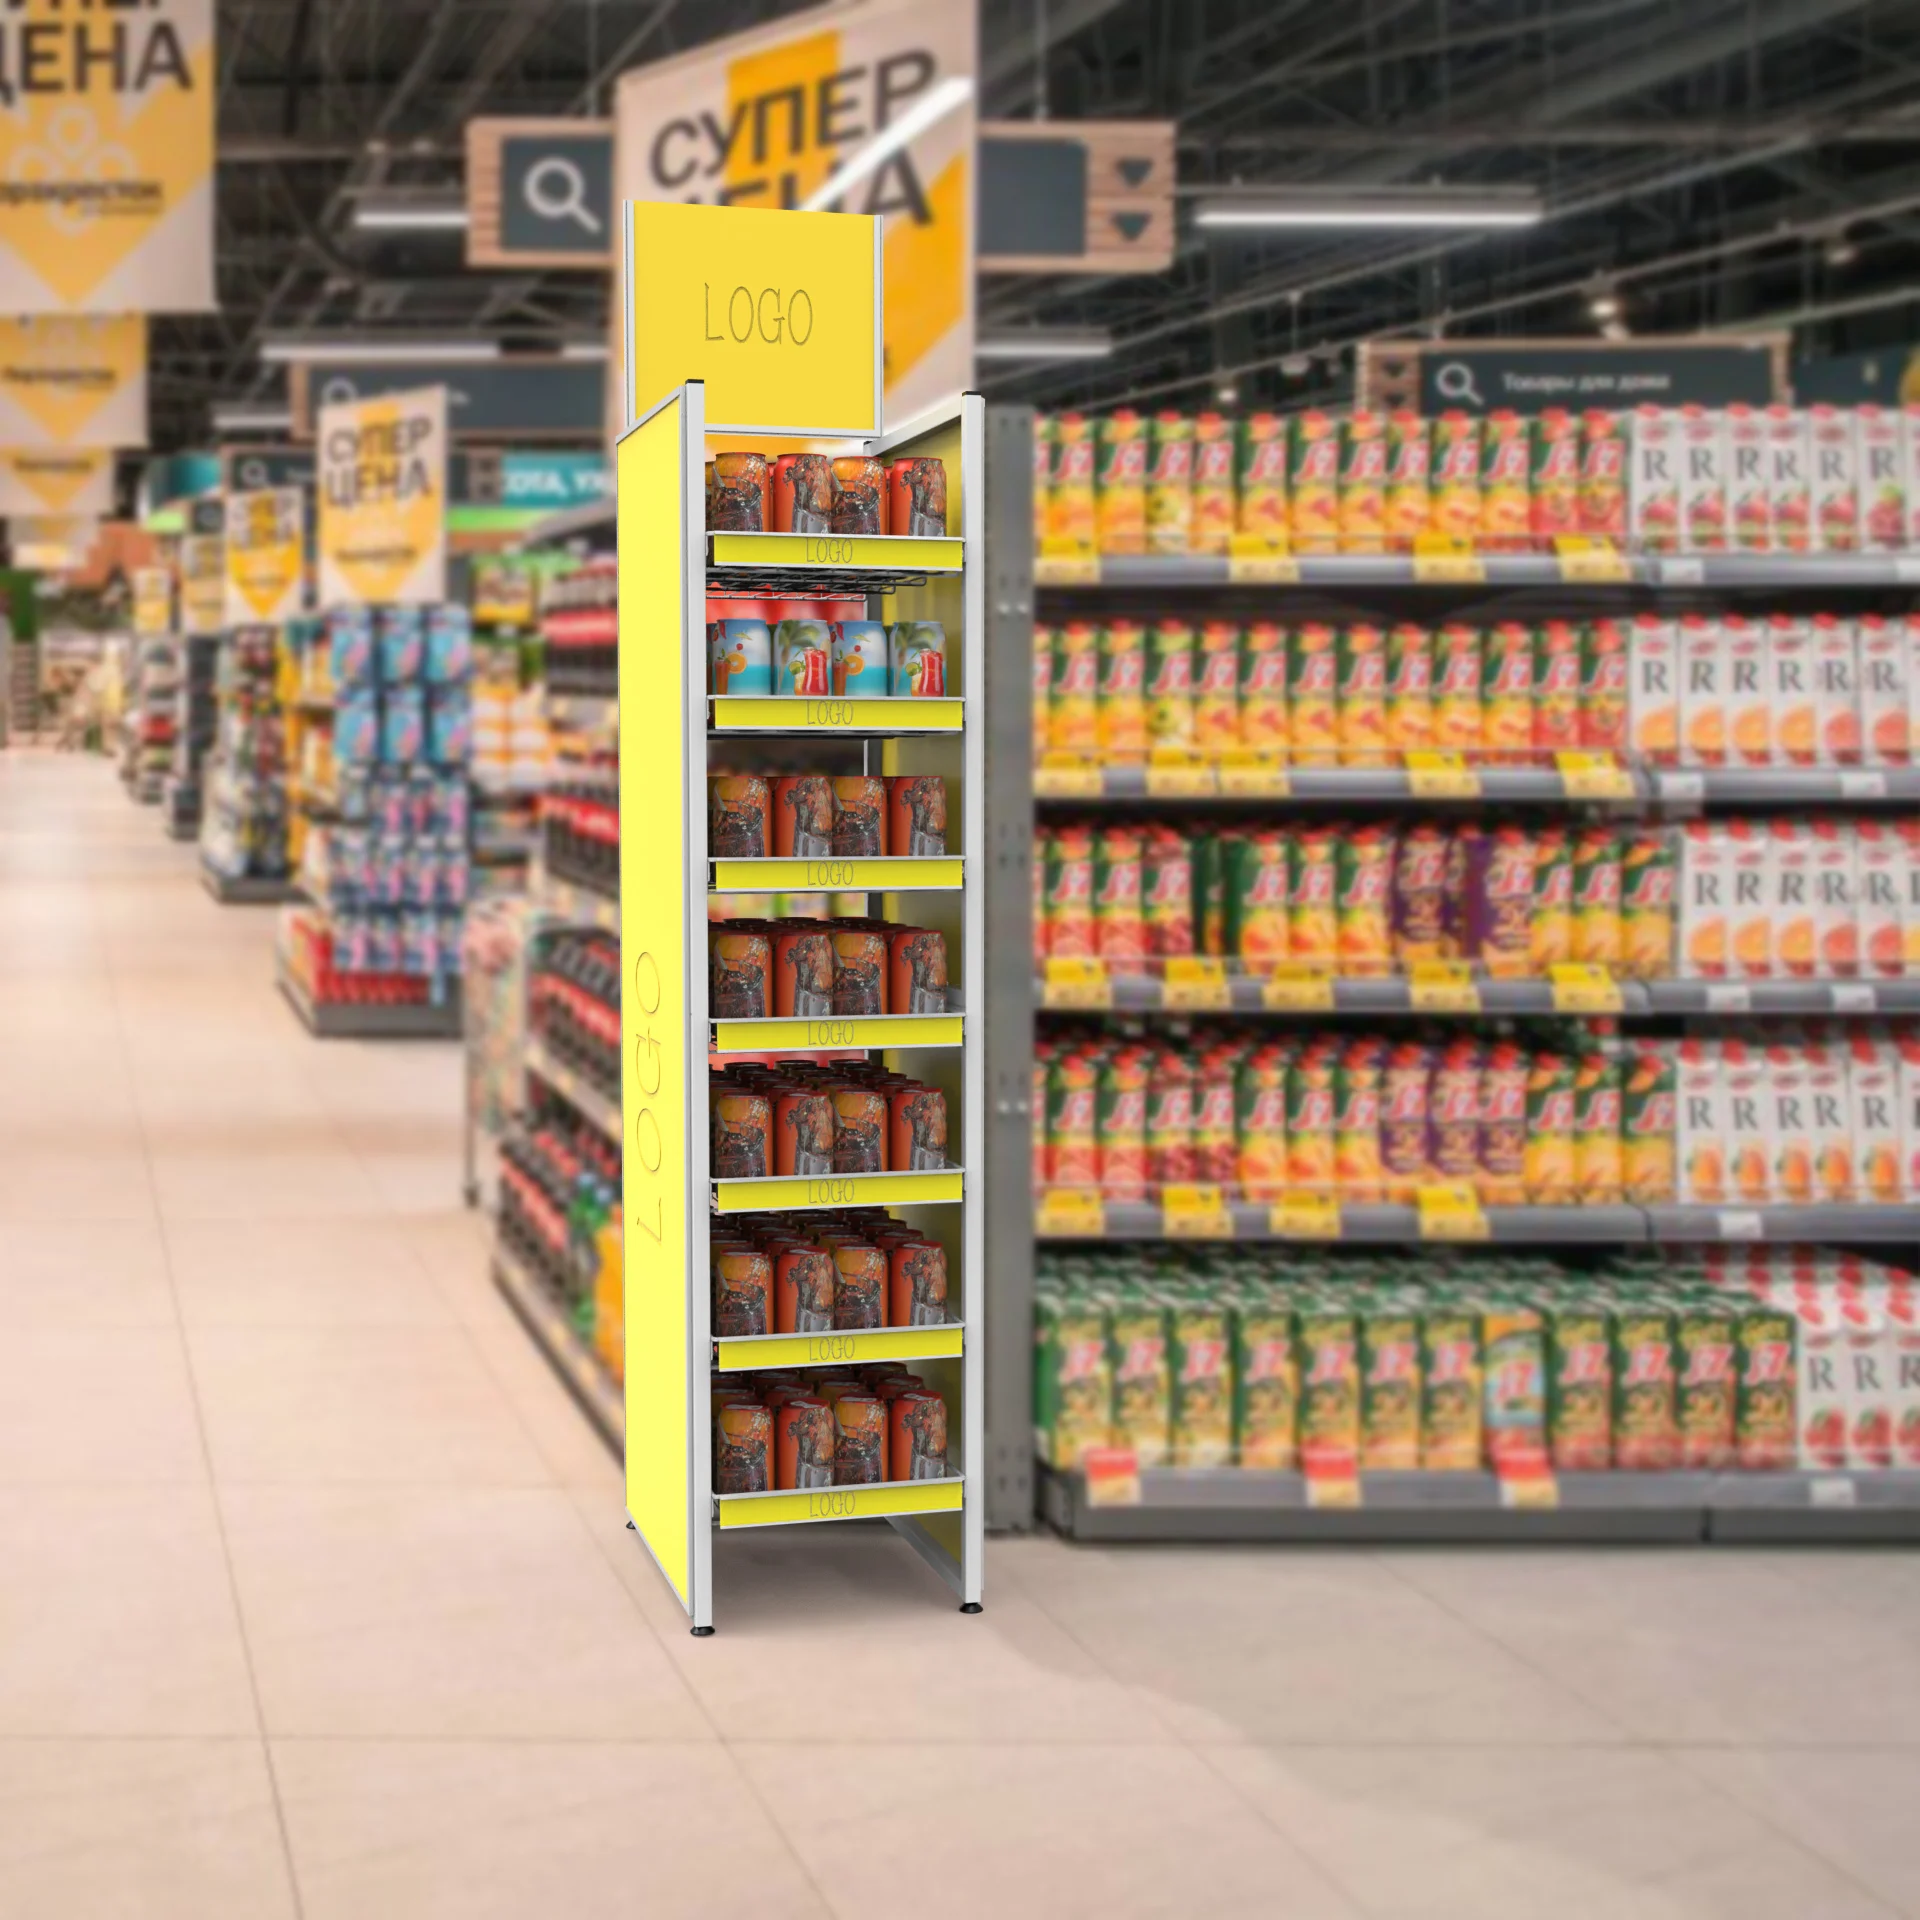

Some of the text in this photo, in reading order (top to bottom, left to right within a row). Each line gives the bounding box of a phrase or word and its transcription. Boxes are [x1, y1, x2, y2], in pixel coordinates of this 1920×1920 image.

[0, 22, 193, 106] ЕНА
[650, 47, 936, 189] СУПЕР
[705, 282, 812, 346] LOGO
[328, 415, 432, 466] СУПЕР
[328, 457, 432, 512] ЦЕНА
[806, 538, 853, 563] LOGO
[807, 700, 854, 725] LOGO
[807, 861, 854, 886] LOGO
[808, 1021, 854, 1046] LOGO
[635, 952, 661, 1246] LOGO
[808, 1178, 855, 1204] LOGO
[809, 1335, 855, 1361] LOGO
[810, 1492, 856, 1517] LOGO
